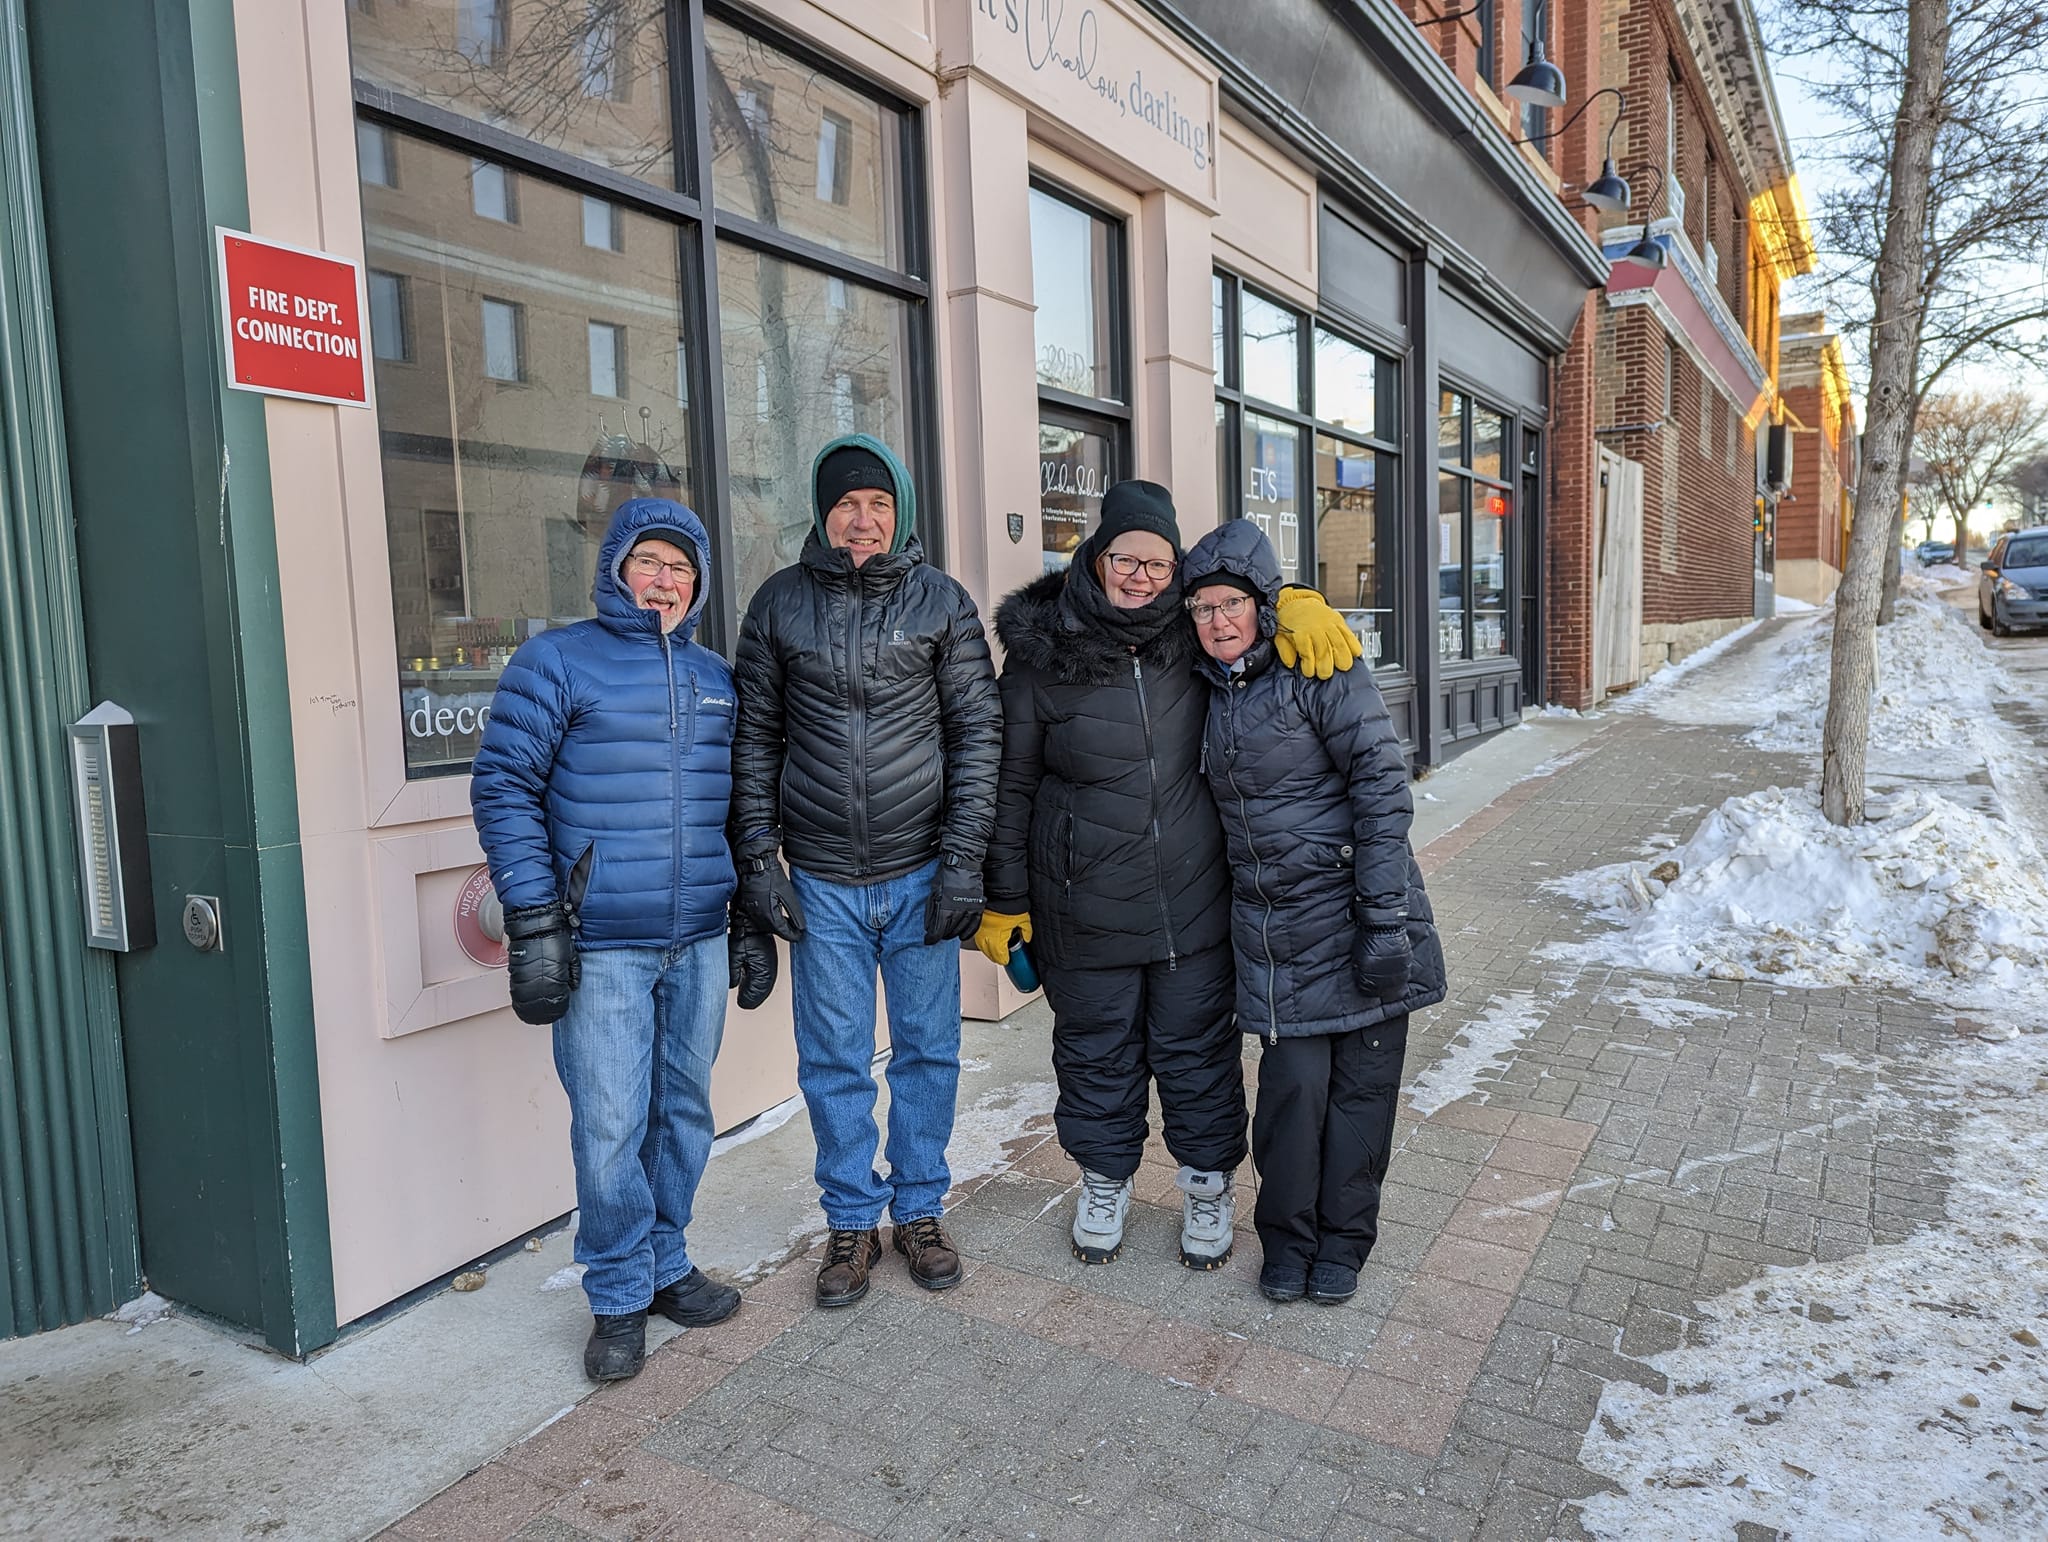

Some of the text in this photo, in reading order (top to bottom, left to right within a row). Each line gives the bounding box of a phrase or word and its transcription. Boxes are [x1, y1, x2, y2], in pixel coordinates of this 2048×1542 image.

[249, 286, 343, 326] FIRE DEPT.
[236, 317, 358, 359] CONNECTION
[471, 895, 482, 912] FIRE
